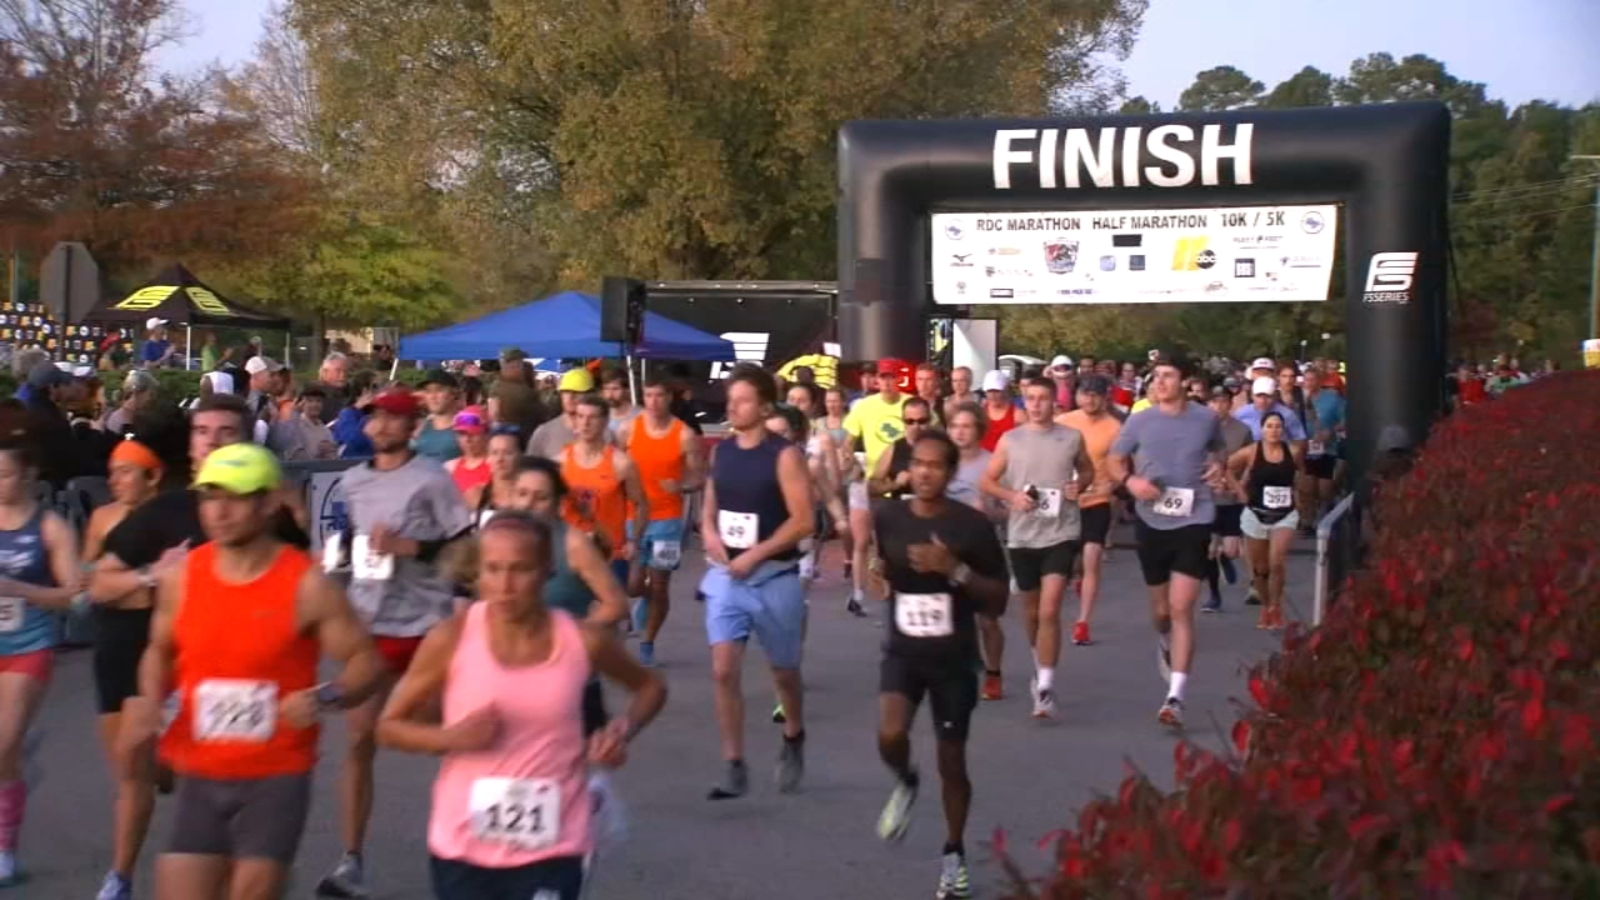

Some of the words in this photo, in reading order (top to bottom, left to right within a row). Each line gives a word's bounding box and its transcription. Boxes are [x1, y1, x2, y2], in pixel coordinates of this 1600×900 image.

[993, 123, 1254, 189] FINISH
[976, 219, 1003, 231] RDC
[1007, 217, 1081, 231] MARATHON
[1092, 216, 1127, 230] HALF
[1131, 215, 1208, 229] MARATHON
[1220, 213, 1247, 227] 10K
[1266, 211, 1285, 226] 5K
[1164, 497, 1183, 510] 69
[727, 525, 745, 539] 49
[906, 609, 944, 627] 119
[486, 802, 546, 833] 121
